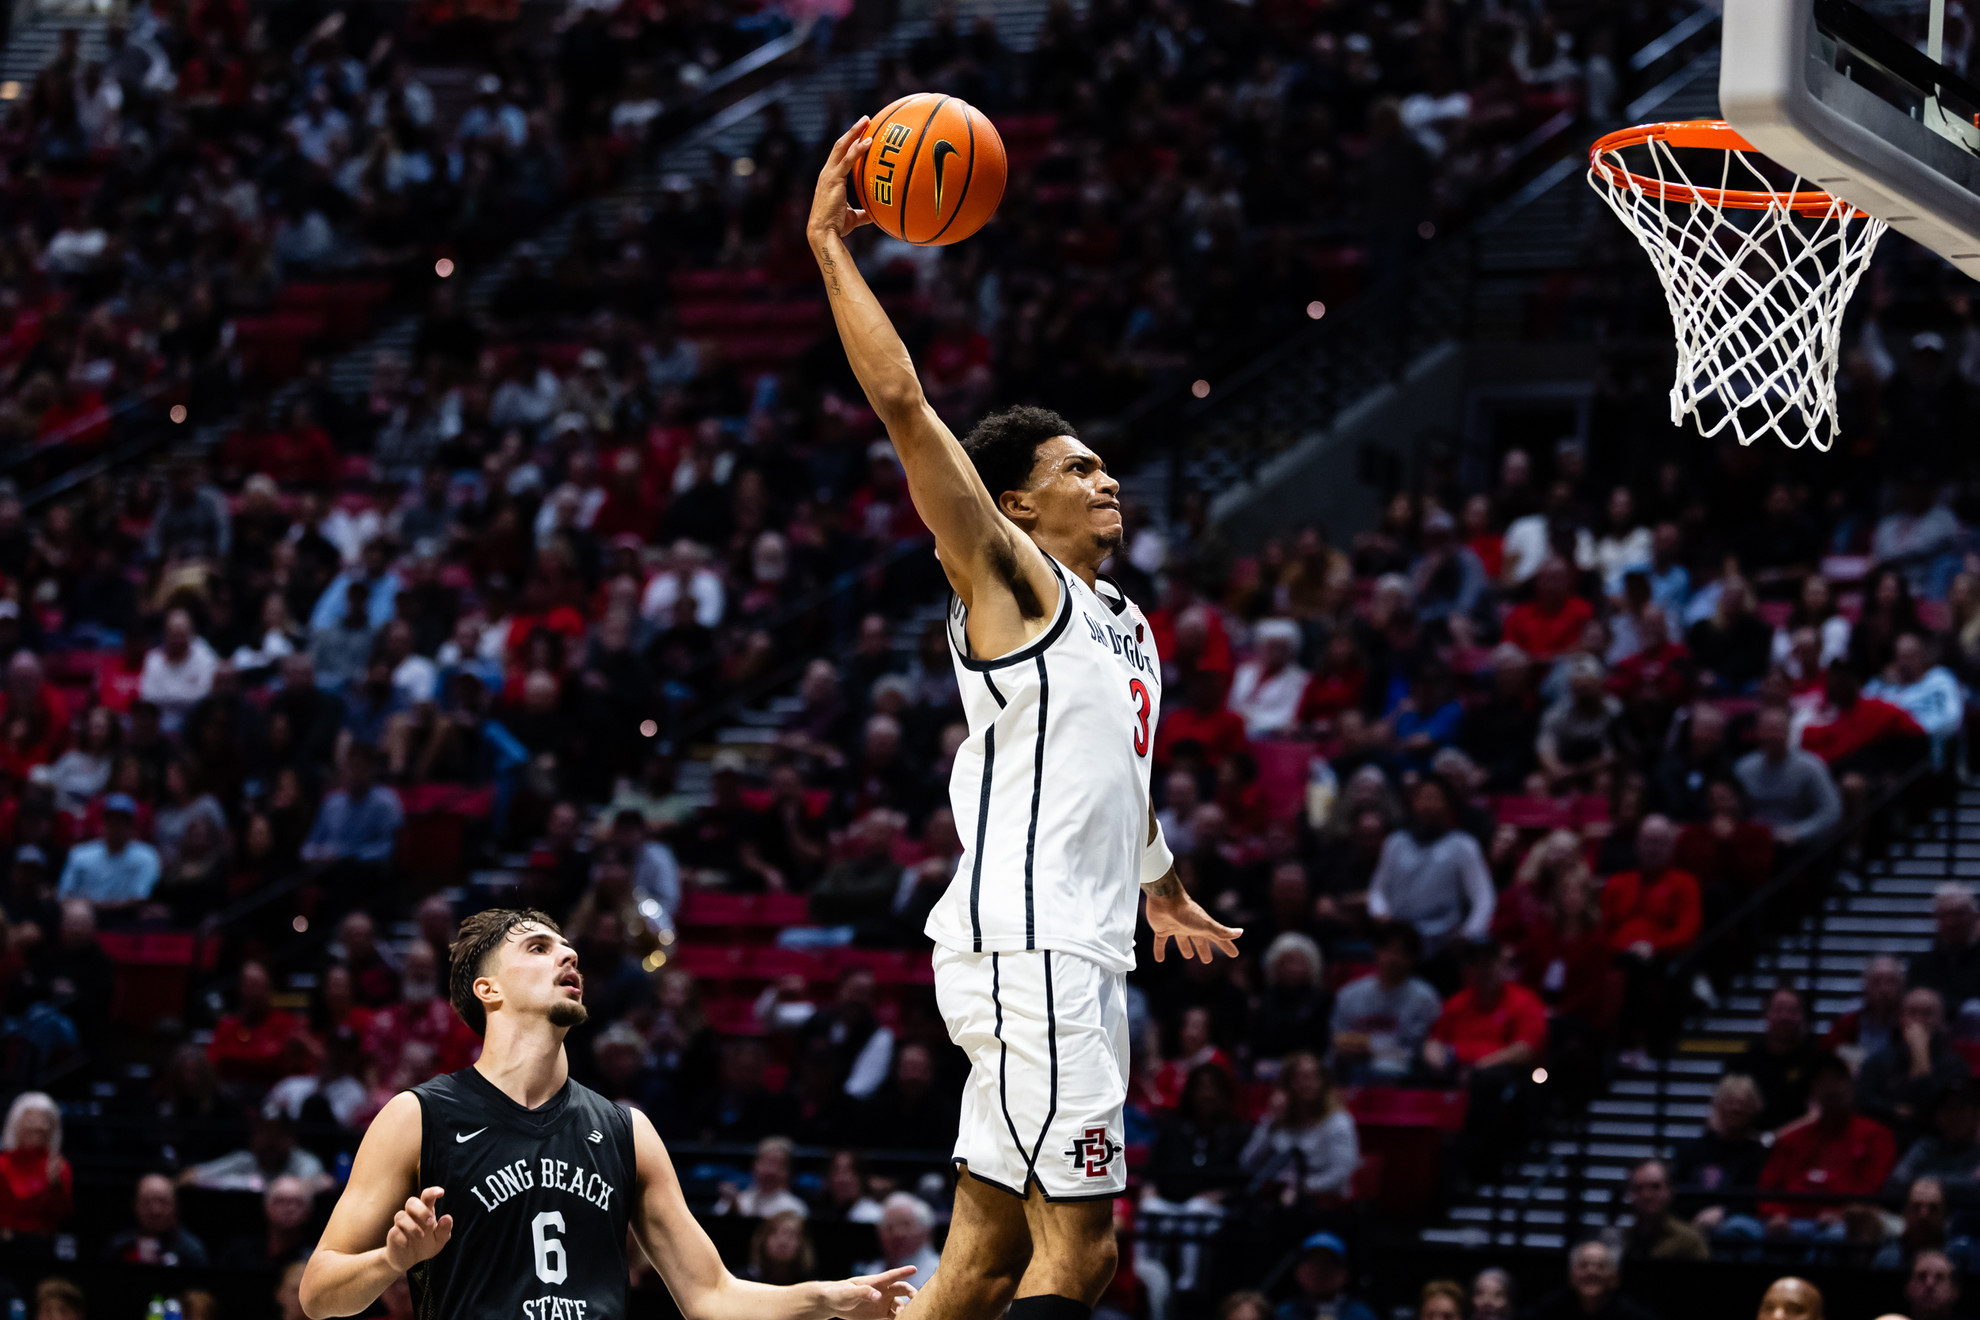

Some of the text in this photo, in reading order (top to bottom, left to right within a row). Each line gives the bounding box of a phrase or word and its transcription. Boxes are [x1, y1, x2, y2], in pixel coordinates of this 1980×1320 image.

[875, 123, 912, 206] ELITE
[1129, 678, 1151, 758] 3
[471, 1158, 614, 1213] LONG BEACH
[531, 1211, 568, 1286] 6
[522, 1295, 587, 1320] STATE
